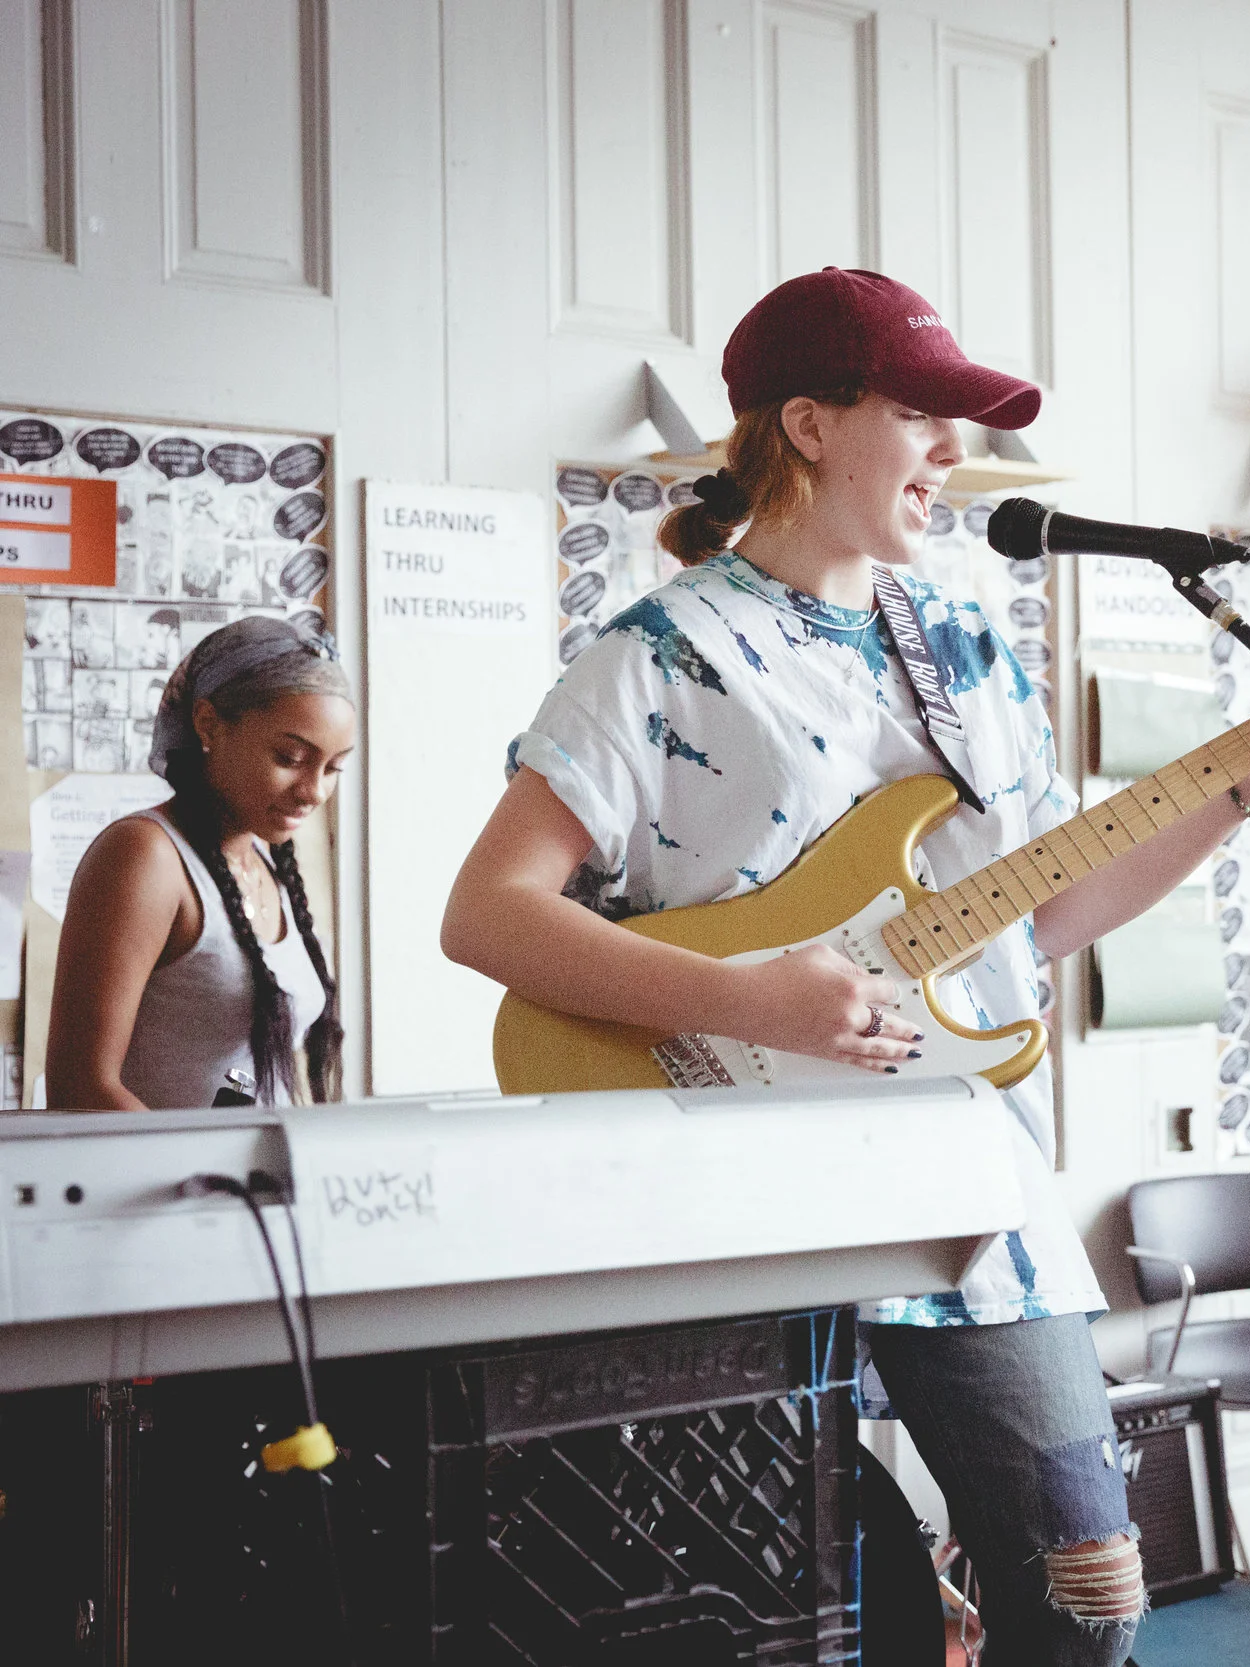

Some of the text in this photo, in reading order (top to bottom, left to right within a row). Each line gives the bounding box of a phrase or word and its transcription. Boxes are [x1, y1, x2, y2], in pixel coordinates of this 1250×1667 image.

[384, 507, 496, 535] LEARNING
[382, 550, 444, 574] THRU
[384, 596, 526, 622] INTERNSHIPS
[871, 566, 926, 655] AILHOUSE
